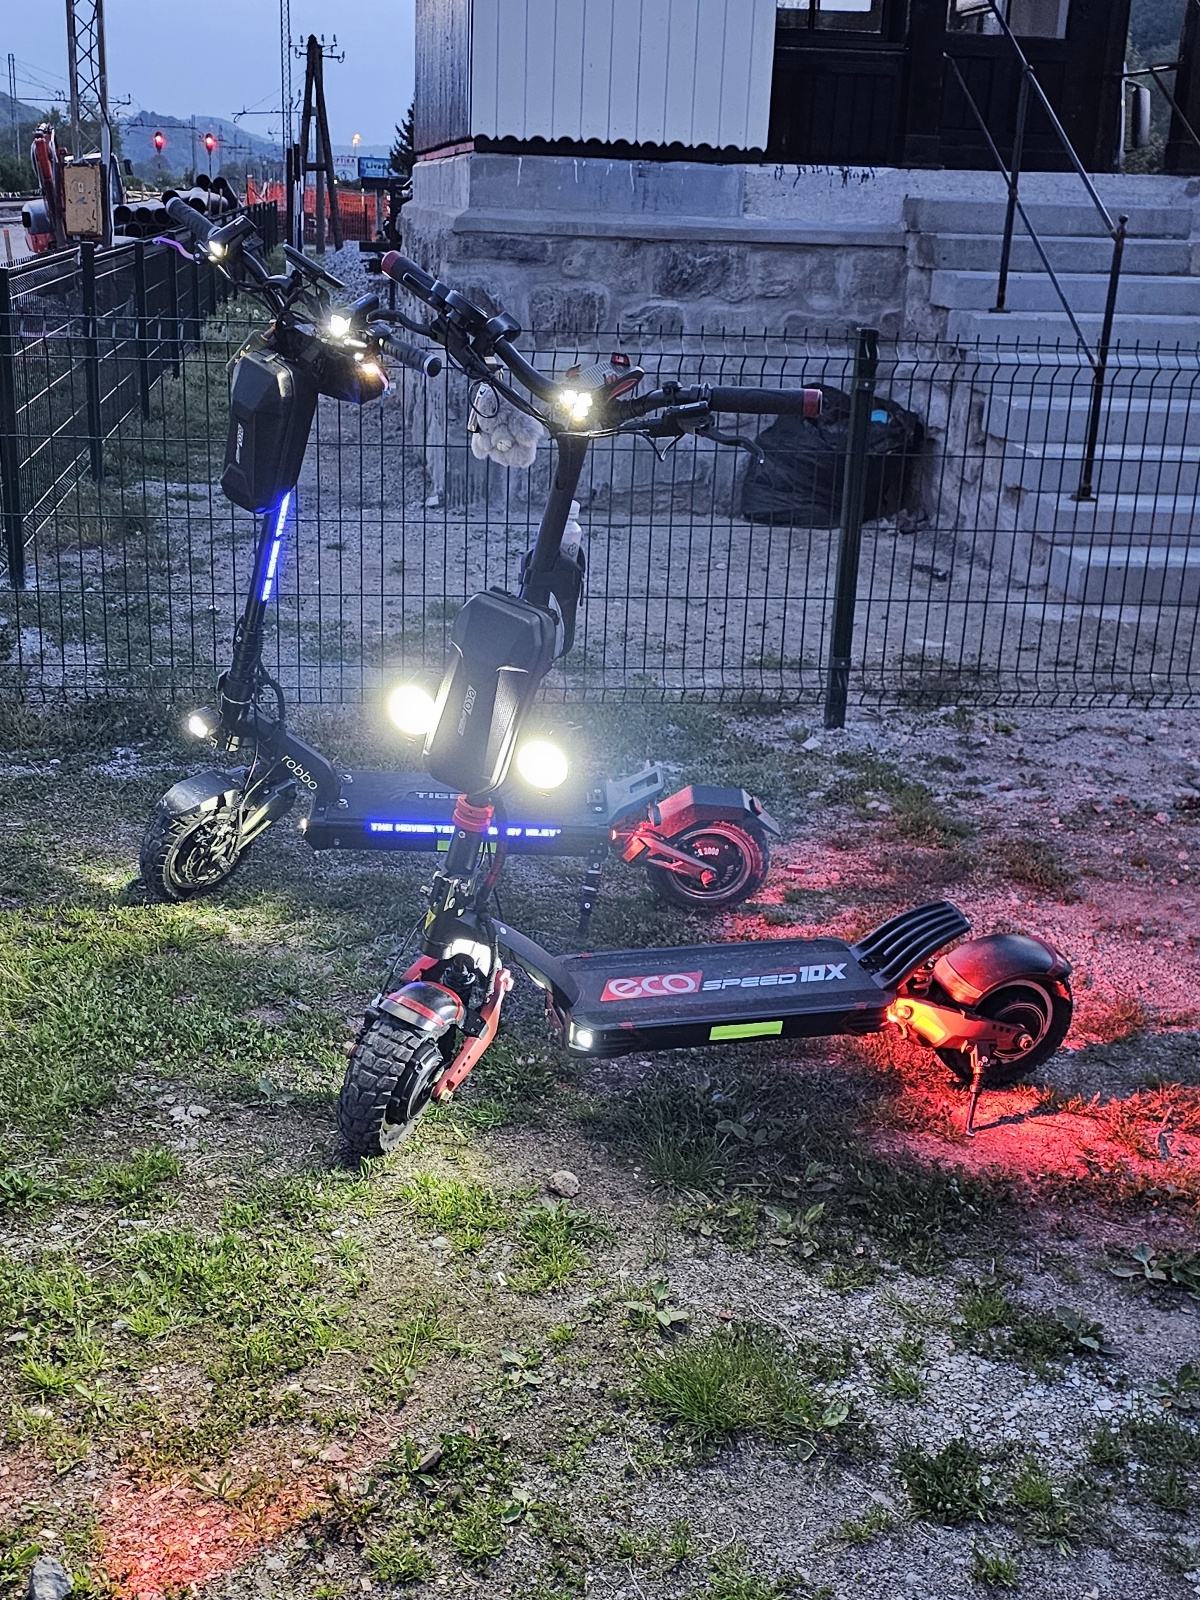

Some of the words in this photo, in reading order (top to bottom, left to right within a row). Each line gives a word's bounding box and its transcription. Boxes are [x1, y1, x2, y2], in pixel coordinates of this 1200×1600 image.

[281, 755, 318, 790] robbo
[608, 973, 697, 998] eco
[702, 973, 797, 992] SPEED
[799, 962, 848, 983] 10X
